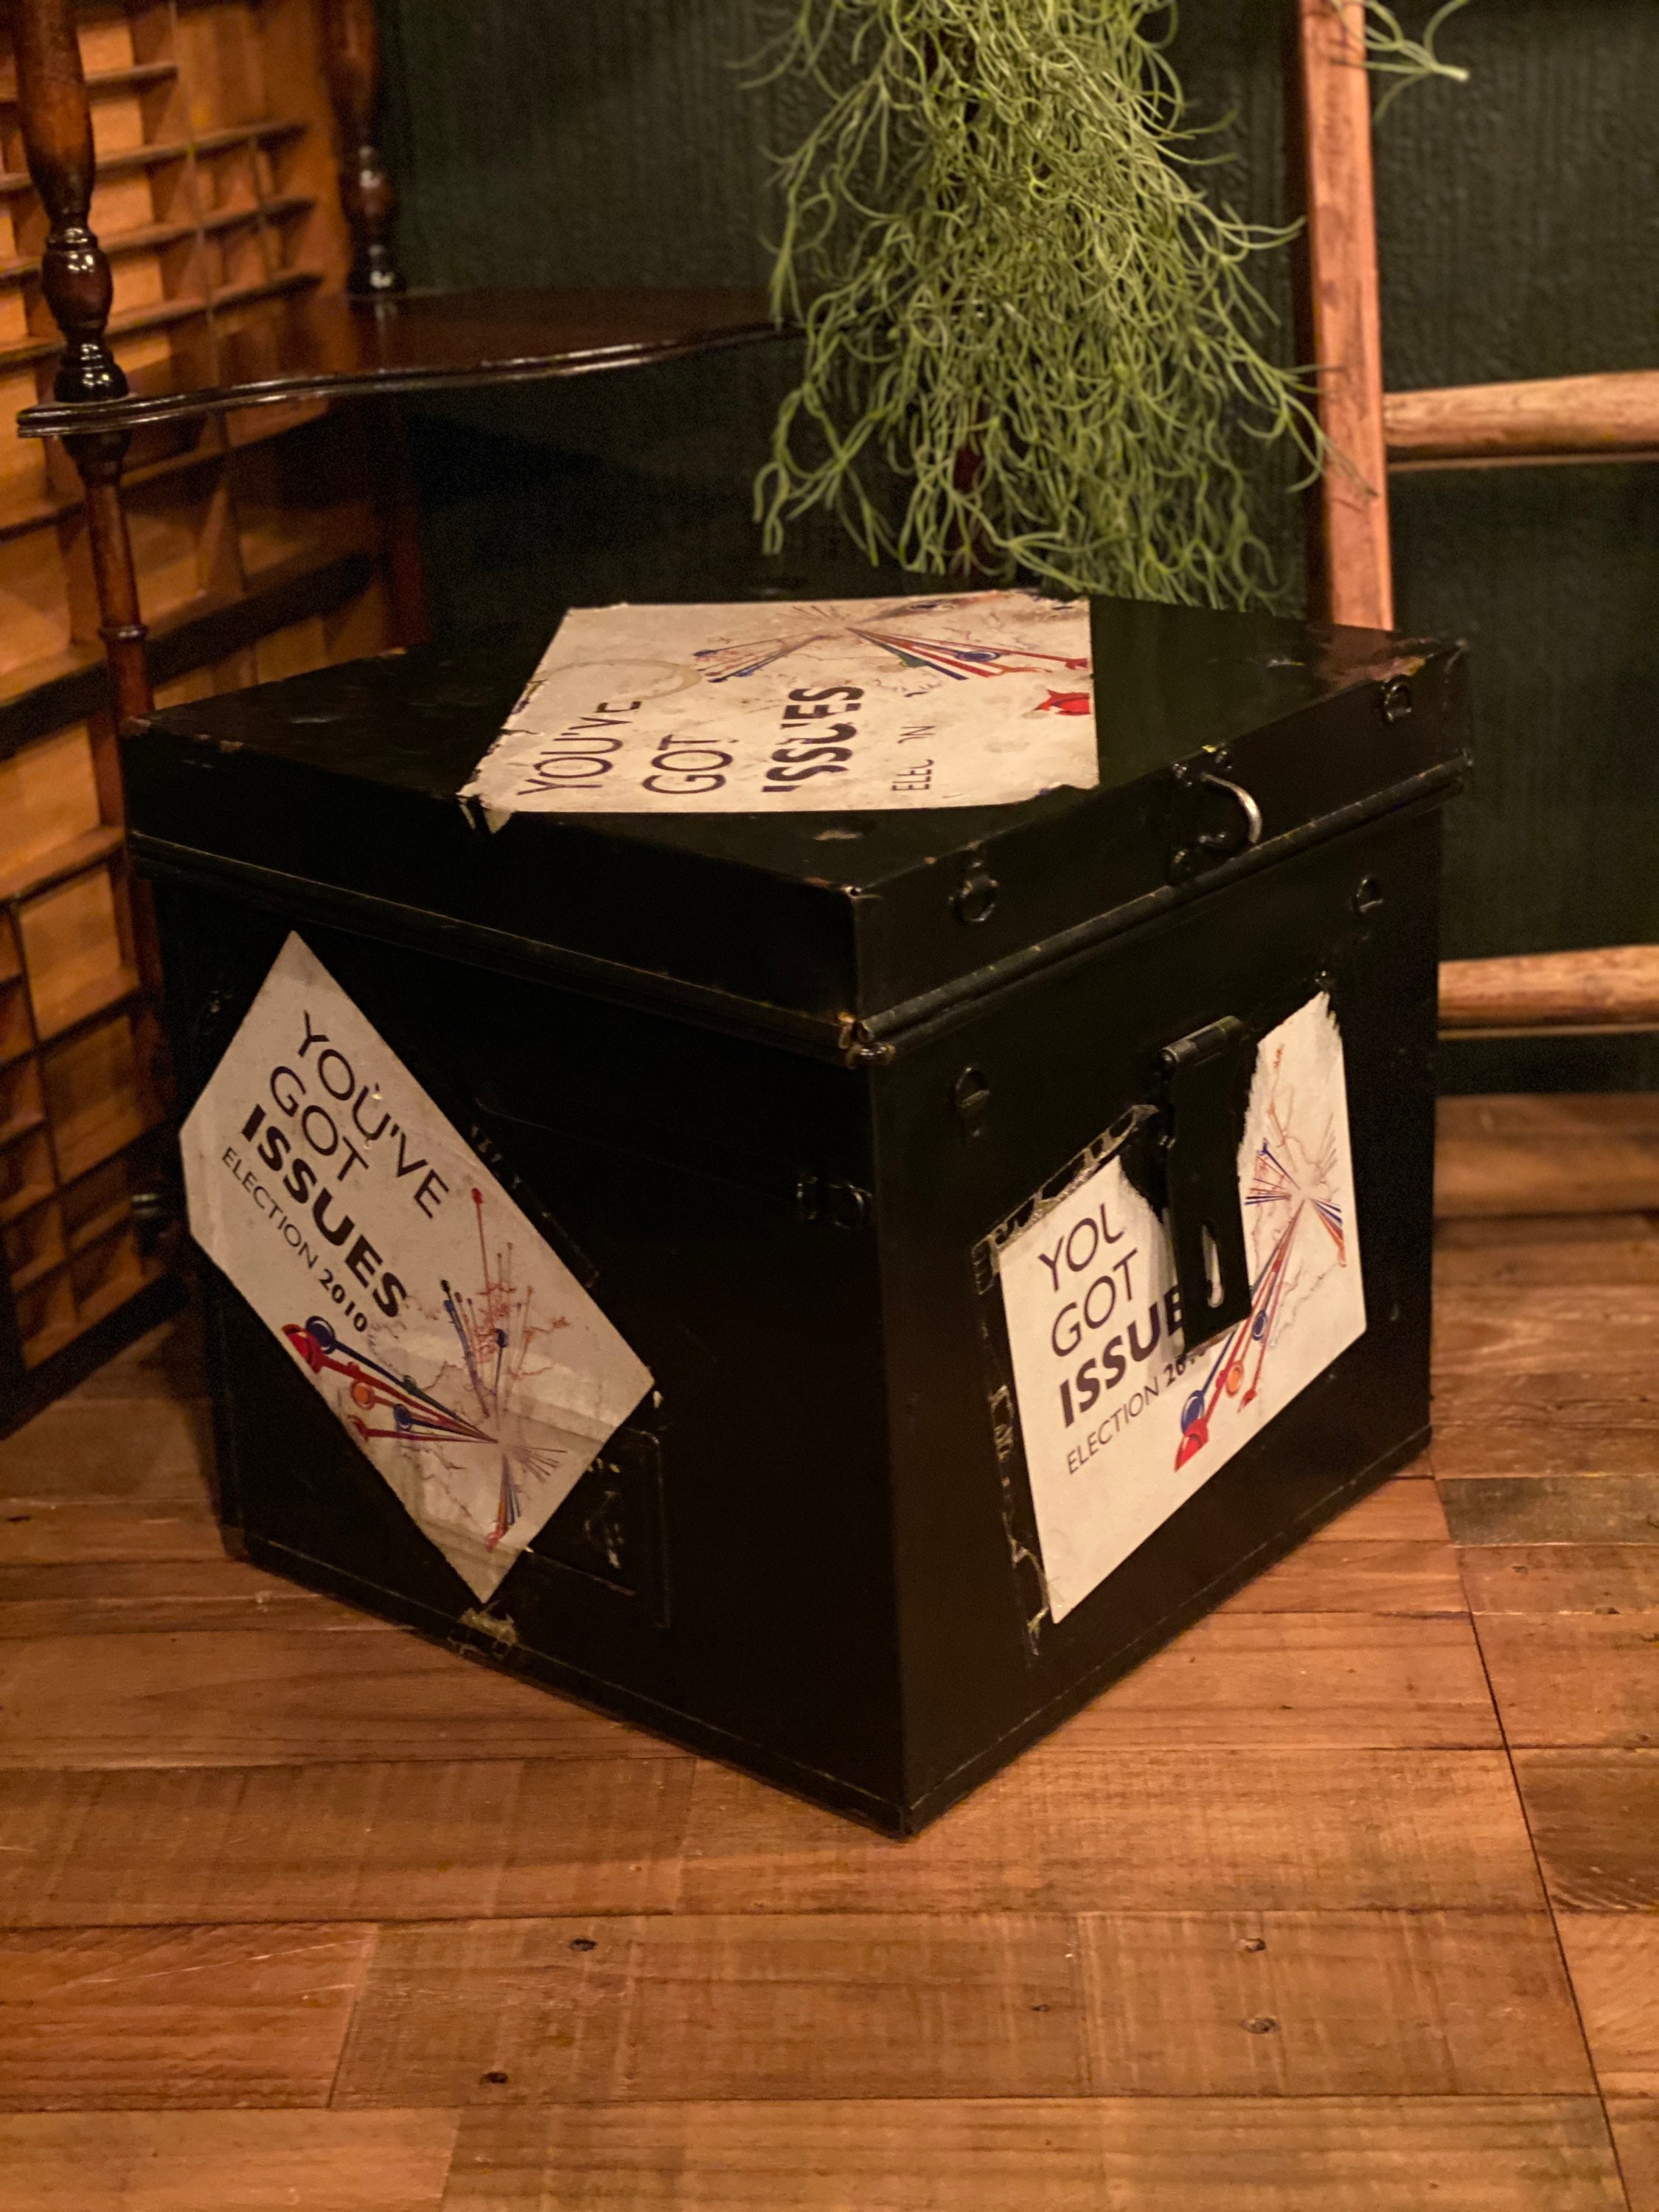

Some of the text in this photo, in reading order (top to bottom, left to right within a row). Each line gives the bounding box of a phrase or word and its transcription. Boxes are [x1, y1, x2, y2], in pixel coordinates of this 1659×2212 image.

[517, 700, 642, 795] YOU'VE
[641, 734, 737, 794] GOT
[761, 686, 864, 793] ISSUES
[270, 1065, 369, 1181] GOT
[297, 1009, 450, 1220] YOU'VE
[222, 1147, 368, 1333] ELECTION 2010
[241, 1104, 407, 1318] ISSUES
[1051, 1248, 1138, 1357] GOT
[1060, 1283, 1184, 1429] ISSUE
[1066, 1349, 1205, 1475] ELECTION 20
